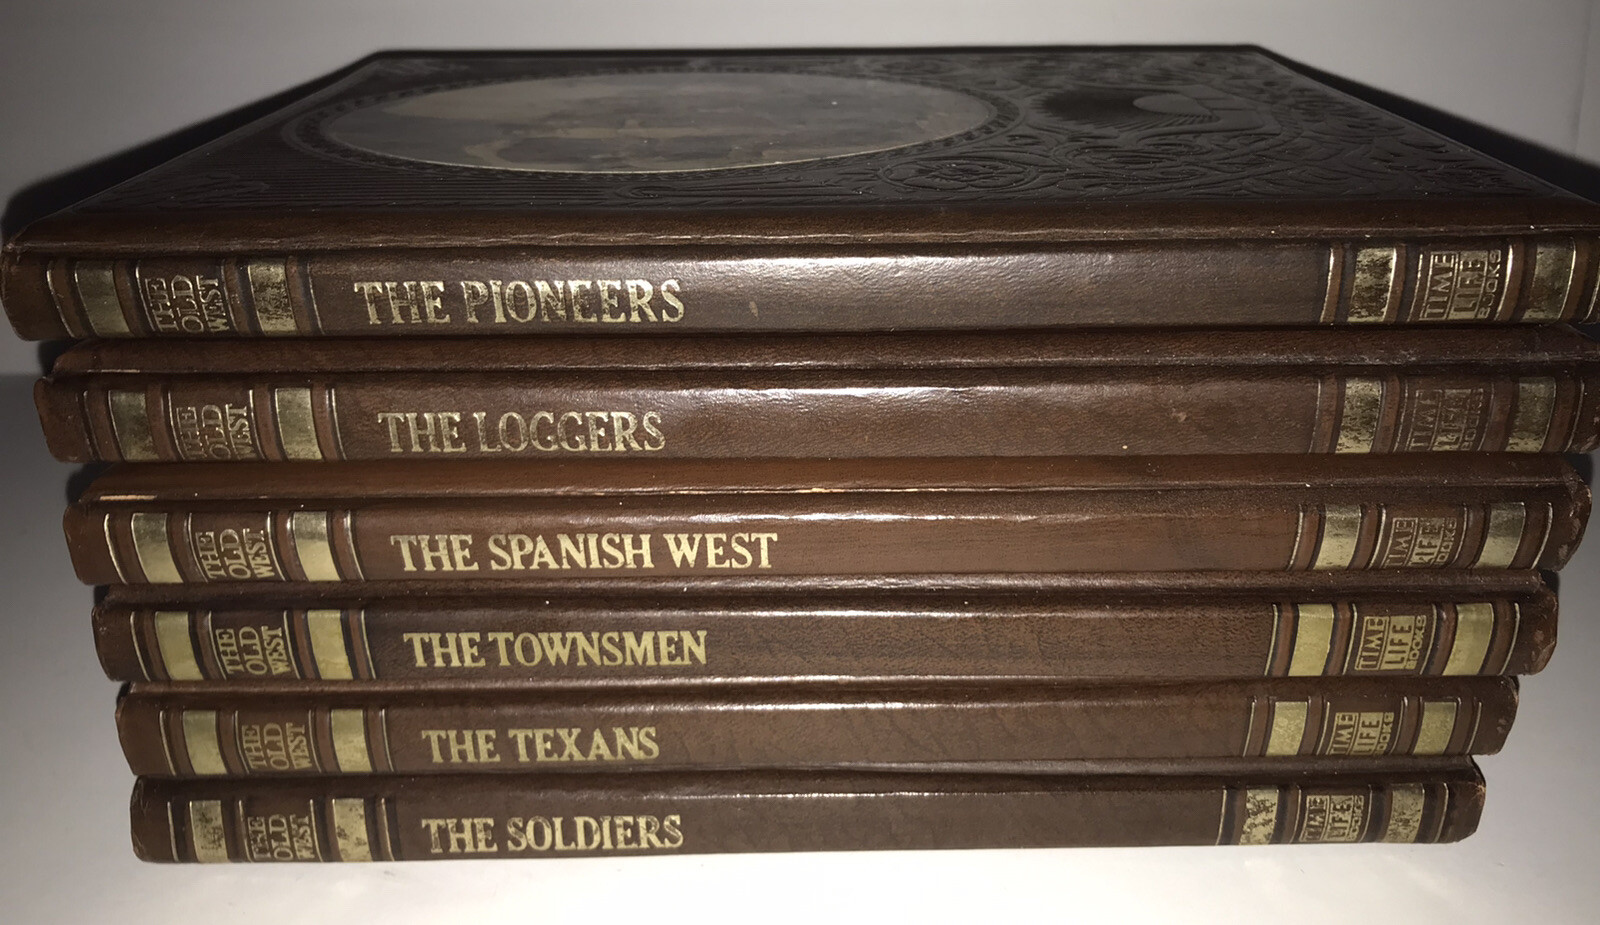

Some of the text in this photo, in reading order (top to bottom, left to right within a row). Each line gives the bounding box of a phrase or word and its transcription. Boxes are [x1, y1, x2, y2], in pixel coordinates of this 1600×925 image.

[145, 278, 179, 331] THE
[171, 275, 204, 333] OLD
[196, 275, 230, 332] WEST
[354, 278, 685, 325] THE PIONEERS
[1424, 254, 1455, 318] TIME
[1450, 255, 1485, 315] LIFE
[201, 404, 231, 459] OLD
[225, 403, 257, 460] WEST
[377, 411, 666, 453] THE LOGGERS
[195, 531, 227, 579] THE
[220, 529, 251, 579] OLD
[243, 528, 275, 578] WEST
[390, 532, 778, 572] THE SPANISH WEST
[1383, 520, 1414, 568] TIME
[215, 628, 245, 674] THE
[239, 626, 268, 675] OLD
[261, 625, 291, 675] WEST
[403, 630, 707, 667] THE TOWNSMEN
[1360, 618, 1385, 668] TIME
[1383, 620, 1413, 667] LIFE
[241, 725, 267, 769] THE
[263, 723, 290, 770] OLD
[285, 722, 312, 769] WEST
[421, 726, 660, 763] THE TEXANS
[1329, 714, 1355, 755] TIME
[1352, 716, 1381, 754] LIFE
[247, 817, 272, 859] THE
[269, 814, 294, 860] OLD
[290, 814, 315, 860] WEST
[421, 814, 684, 853] THE SOLDIERS
